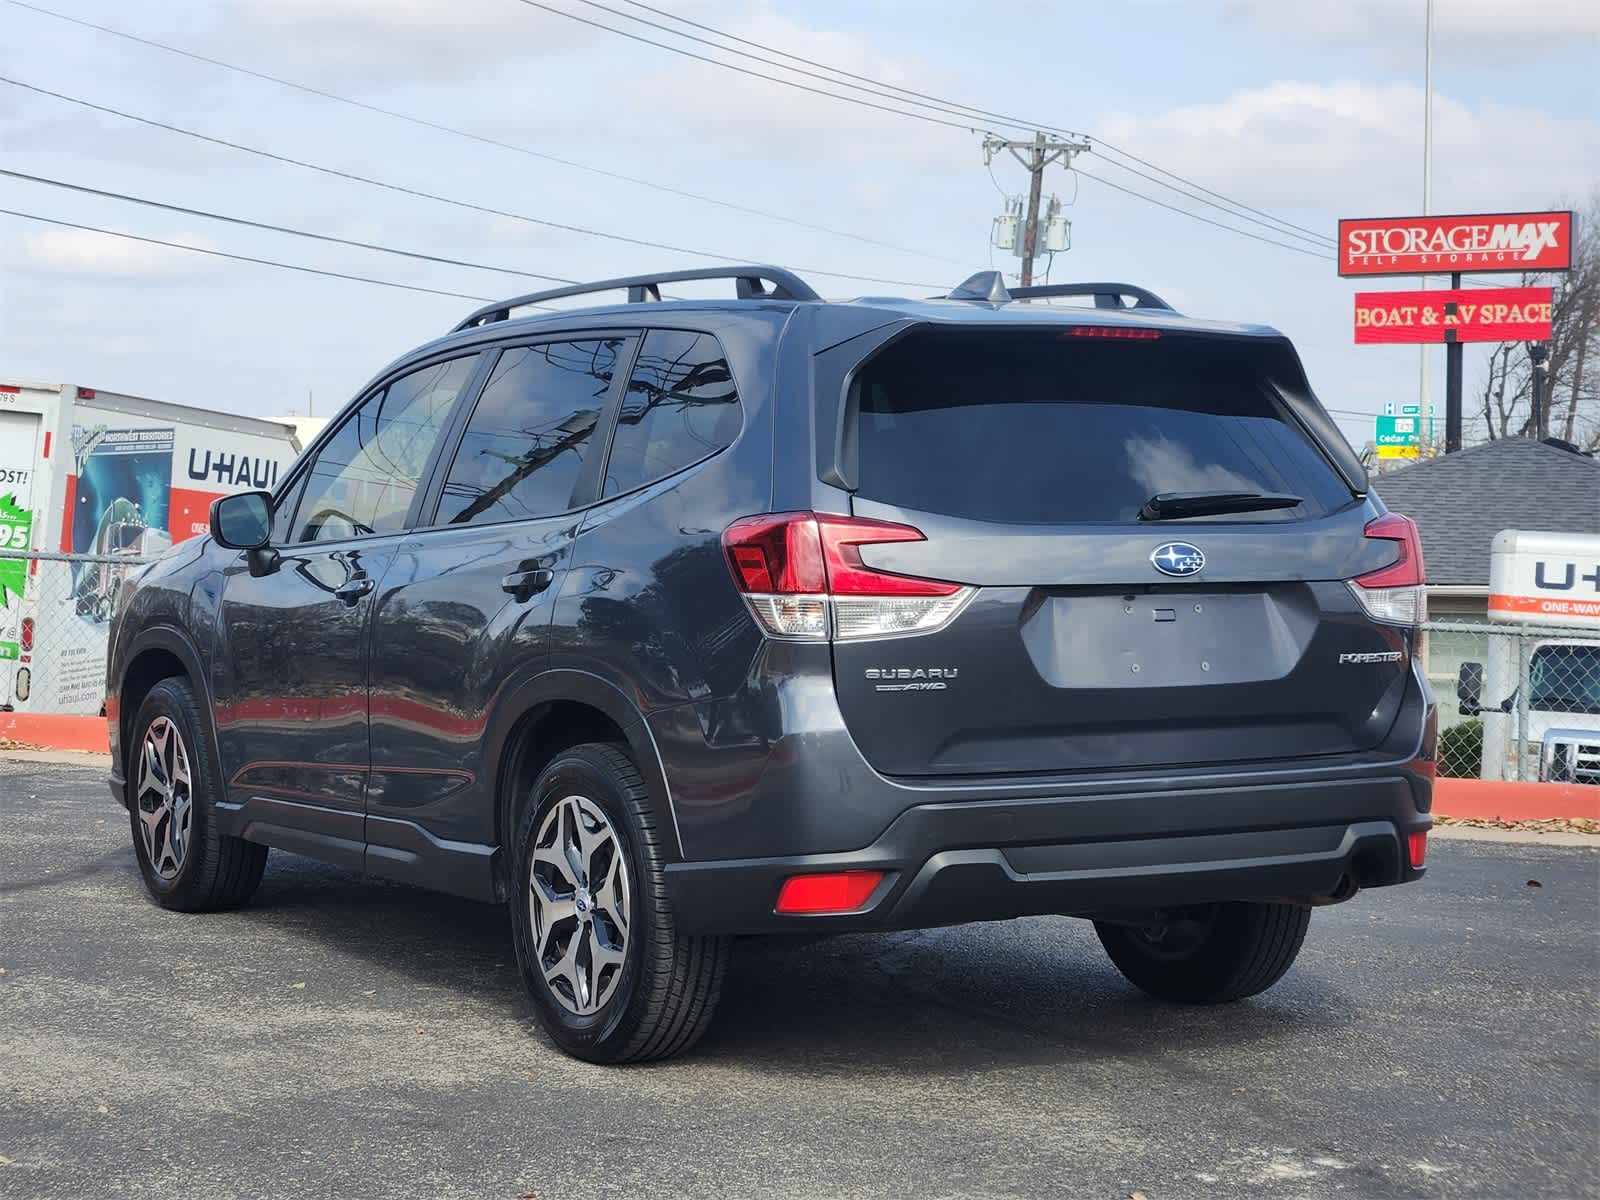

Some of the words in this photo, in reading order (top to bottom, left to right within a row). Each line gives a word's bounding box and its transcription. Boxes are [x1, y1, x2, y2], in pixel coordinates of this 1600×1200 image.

[1348, 221, 1560, 261] STORAGEMAX
[1349, 255, 1398, 266] SELF
[1421, 251, 1520, 265] STORAGE
[1356, 307, 1417, 328] BOAT
[1420, 306, 1438, 326] &
[1479, 303, 1552, 323] SPACE
[1535, 562, 1600, 593] U-
[1338, 652, 1402, 664] FORESTER
[865, 668, 958, 679] SUBARU
[900, 682, 947, 692] AWD
[58, 690, 98, 705] uhaul.com
